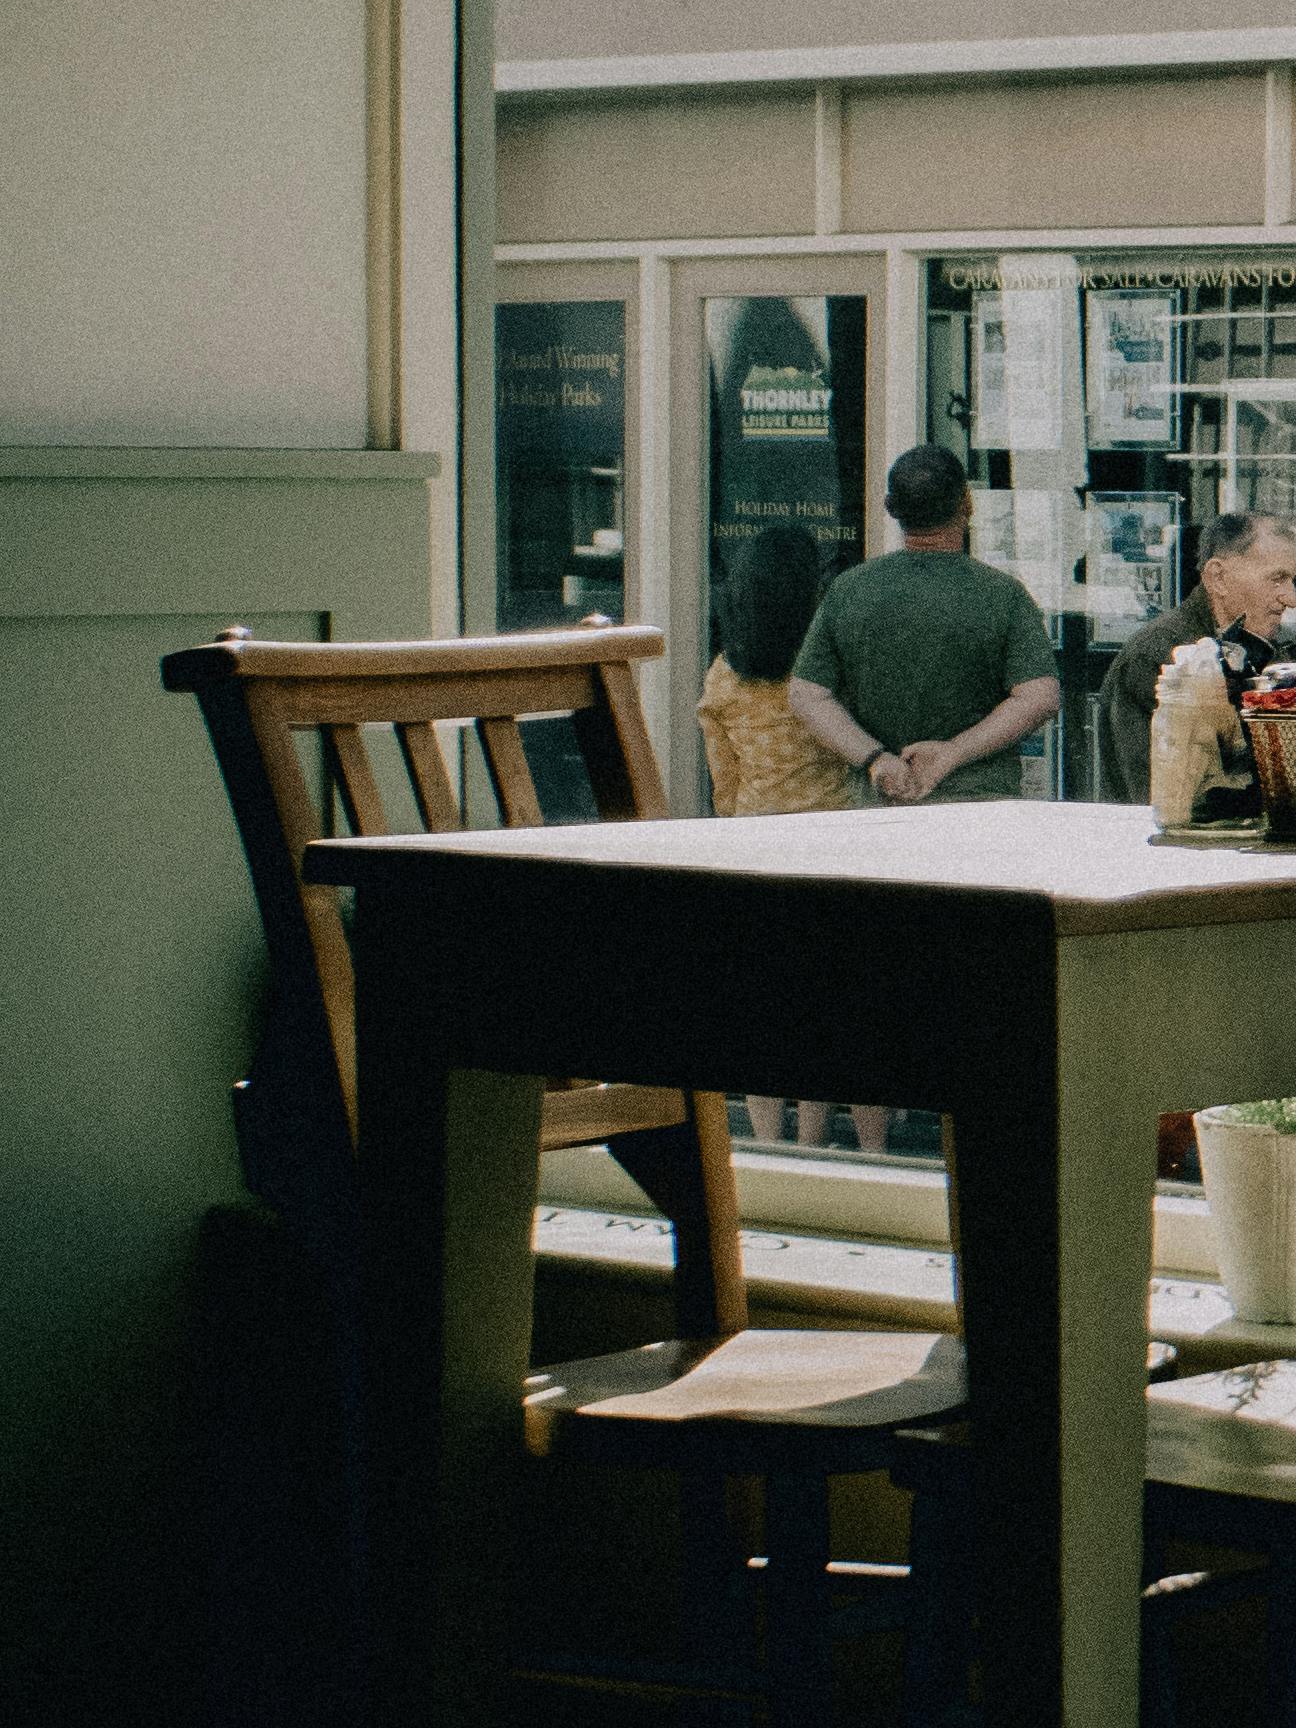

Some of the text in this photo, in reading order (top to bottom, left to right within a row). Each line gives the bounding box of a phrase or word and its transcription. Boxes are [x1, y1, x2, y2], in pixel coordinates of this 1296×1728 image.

[950, 267, 1060, 290] CARAVANS
[1102, 266, 1147, 288] SALE
[1157, 264, 1262, 288] CARAVANS
[554, 346, 621, 377] Winning
[562, 381, 603, 407] Parks
[740, 390, 832, 410] THORNLEY
[742, 415, 830, 428] LEISURE PARKS
[734, 500, 836, 518] HOLIDAY HOME
